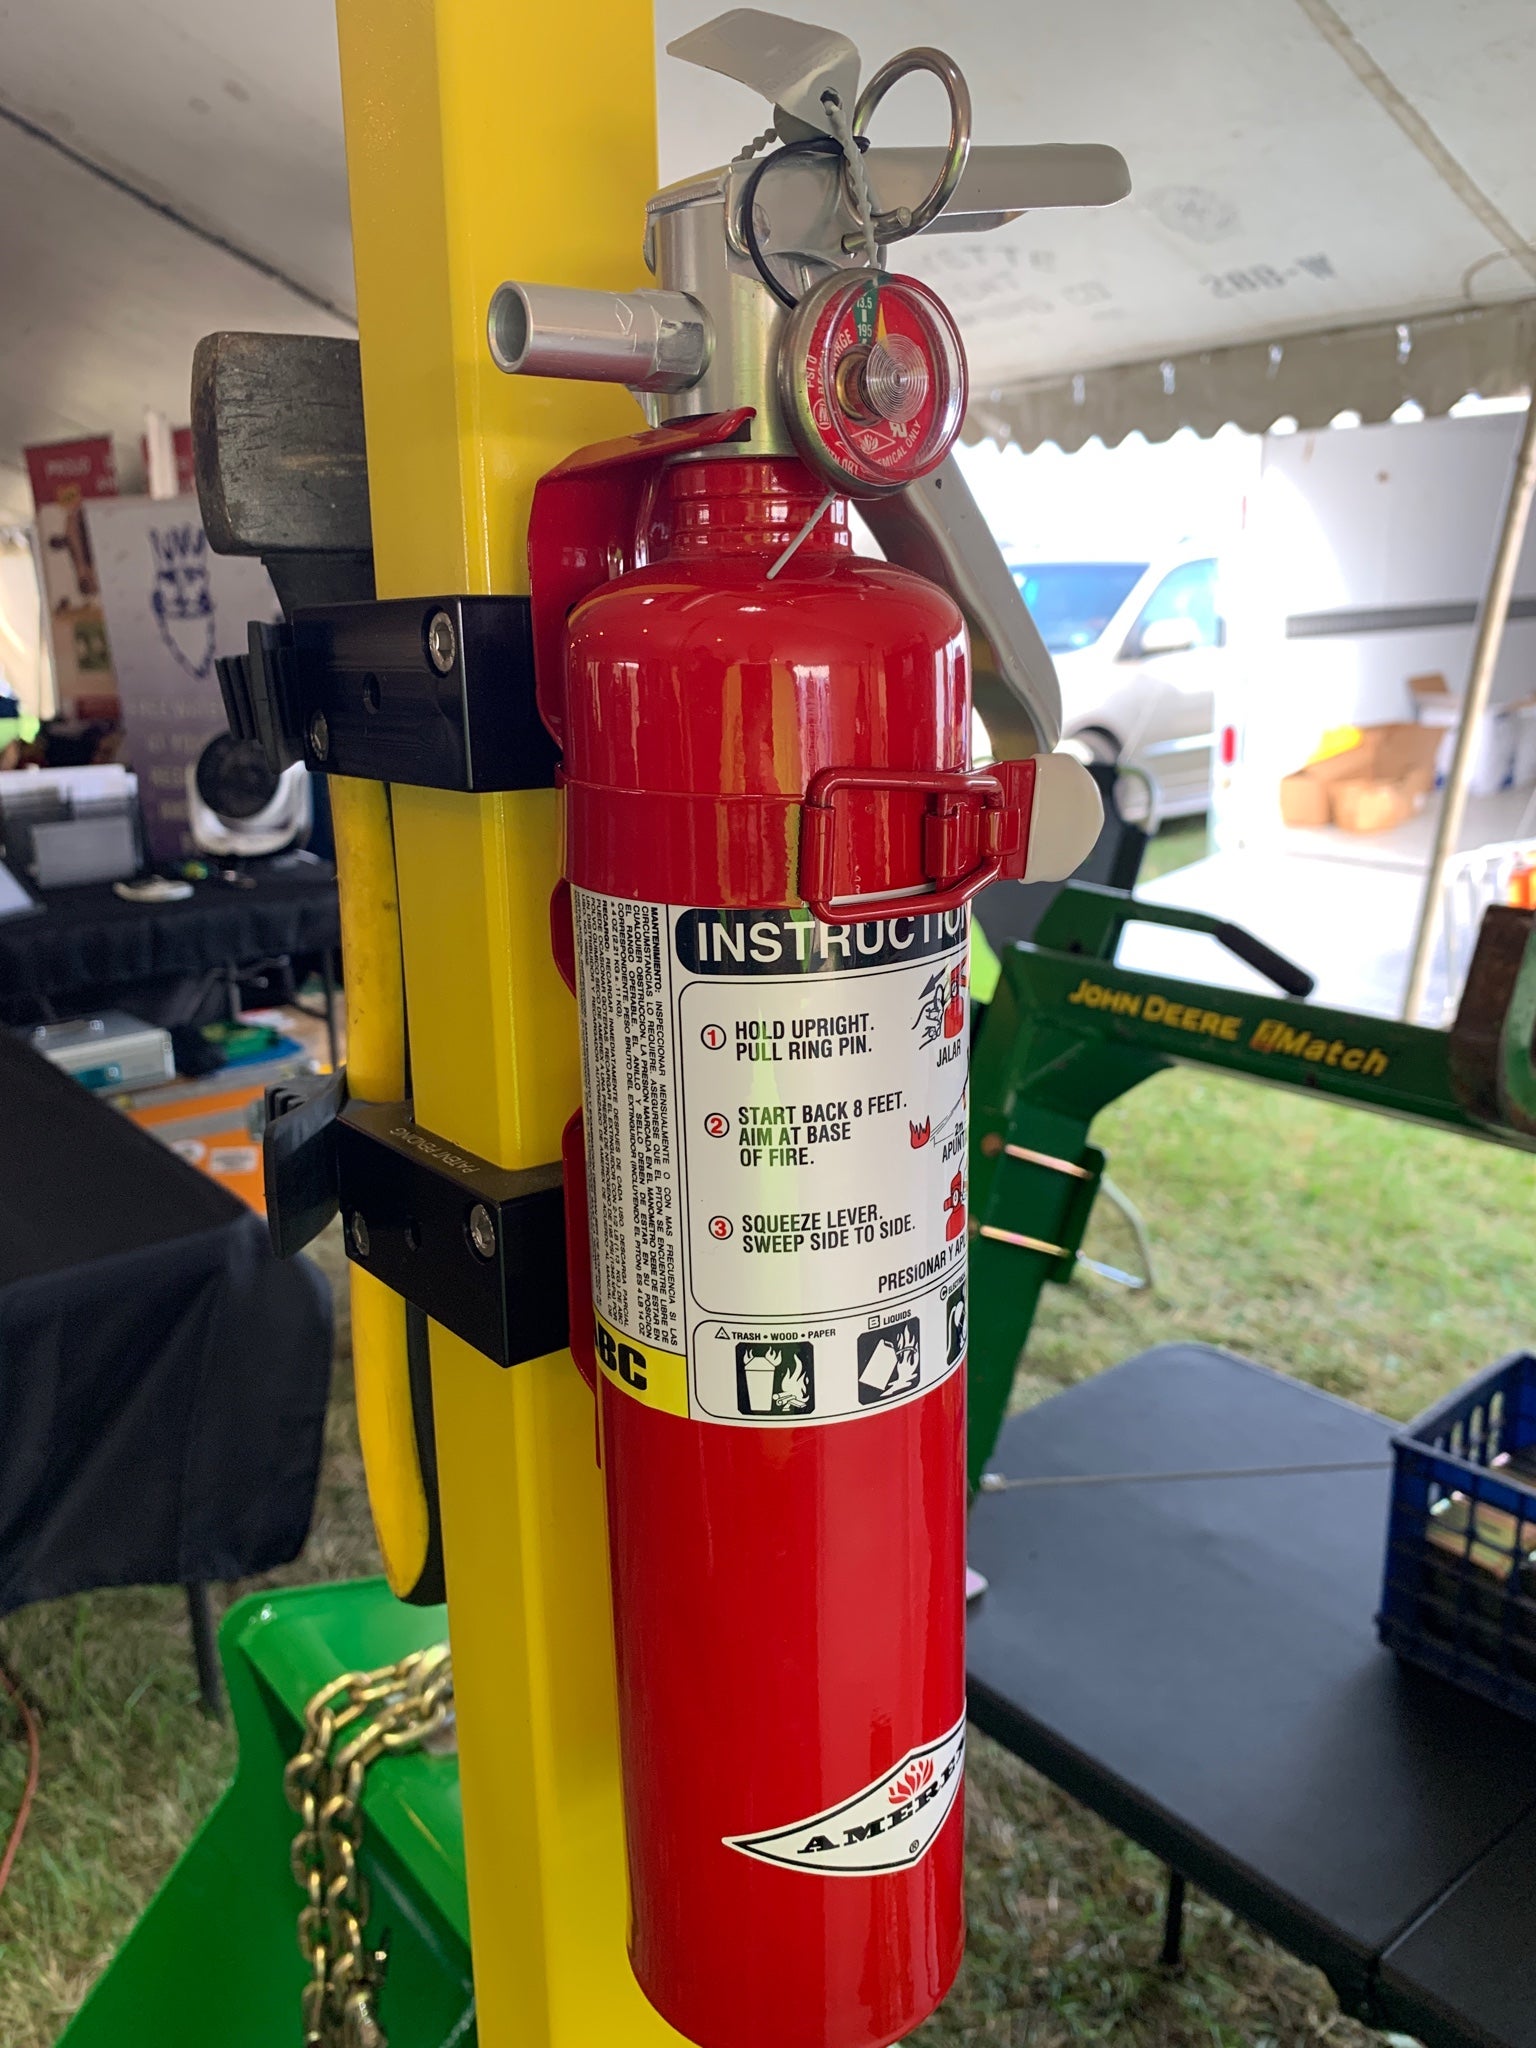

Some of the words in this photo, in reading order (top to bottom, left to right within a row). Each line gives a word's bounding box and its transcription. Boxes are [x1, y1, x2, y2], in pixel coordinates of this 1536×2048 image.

[858, 324, 872, 337] 195
[906, 419, 922, 449] ONLY
[625, 904, 632, 916] EL
[626, 925, 634, 963] RANGO
[633, 905, 643, 963] CUALQUIER
[618, 903, 629, 1003] CORRESPONDIENTE.
[651, 907, 662, 993] MANTENIMIENTO:
[605, 957, 613, 1013] RECARGAR
[628, 970, 637, 1027] OPERABLE.
[636, 966, 646, 1040] OBSTRUCCION.
[646, 1002, 654, 1015] LO
[1068, 979, 1142, 1017] JOHN
[1142, 995, 1243, 1041] DEERE
[632, 1035, 638, 1047] EL
[655, 1001, 666, 1076] INSPECCIONAR
[735, 1020, 785, 1041] HOLD
[792, 1013, 875, 1039] UPRIGHT.
[608, 1018, 618, 1103] INMEDIATAMENTE
[624, 1036, 632, 1070] BRUTO
[639, 1044, 647, 1056] LA
[647, 1021, 657, 1074] REQUIERE.
[736, 1041, 783, 1062] PULL
[789, 1038, 833, 1061] RING
[839, 1034, 872, 1056] PIN.
[936, 1040, 962, 1068] JALAR
[632, 1055, 641, 1090] ANILLO
[640, 1059, 649, 1103] PRESION
[650, 1079, 660, 1139] ASEGURESE
[738, 1105, 797, 1126] START
[802, 1101, 848, 1123] BACK
[853, 1099, 863, 1118] 8
[868, 1091, 907, 1116] FEET.
[627, 1094, 636, 1158] EXTINGUIDOR
[635, 1113, 643, 1144] SELLO
[642, 1105, 651, 1152] MARCADA
[659, 1084, 670, 1164] MENSUALMENTE
[738, 1127, 773, 1147] AIM
[779, 1126, 801, 1145] AT
[807, 1121, 851, 1144] BASE
[389, 1127, 437, 1157] PENDING
[653, 1144, 661, 1164] QUE
[942, 1130, 965, 1163] APUNT
[432, 1150, 480, 1174] PATENT
[637, 1151, 645, 1185] DEBEN
[645, 1156, 652, 1169] EN
[739, 1148, 763, 1167] OF
[769, 1147, 815, 1167] FIRE.
[645, 1172, 653, 1184] EL
[654, 1170, 661, 1181] EL
[663, 1172, 671, 1180] O
[630, 1161, 639, 1224] (INCLUYENDO
[639, 1192, 646, 1206] DE
[655, 1186, 663, 1215] PITON
[663, 1187, 672, 1208] CON
[640, 1213, 648, 1245] ESTAR
[646, 1187, 656, 1247] MANOMETRO
[656, 1220, 664, 1232] SE
[665, 1216, 673, 1236] MAS
[742, 1212, 821, 1233] SQUEEZE
[826, 1204, 883, 1229] LEVER.
[633, 1226, 640, 1237] EL
[742, 1235, 805, 1253] SWEEP
[810, 1231, 849, 1251] SIDE
[854, 1225, 875, 1245] TO
[879, 1214, 916, 1240] SIDE.
[619, 1233, 627, 1284] DESCARGA
[642, 1252, 649, 1266] EN
[649, 1251, 657, 1276] DEBE
[657, 1237, 667, 1295] ENCUENTRE
[878, 1250, 946, 1294] PRESIONAR
[948, 1243, 953, 1261] Y
[636, 1273, 642, 1285] ES
[643, 1272, 650, 1286] SU
[651, 1279, 658, 1292] DE
[666, 1244, 676, 1304] FRECUENCIA
[637, 1296, 643, 1307] LB
[638, 1311, 644, 1320] 14
[651, 1295, 659, 1325] ESTAR
[660, 1299, 668, 1326] LIBRE
[638, 1322, 645, 1336] OZ
[644, 1293, 652, 1339] POSICION
[669, 1312, 677, 1321] SI
[883, 1309, 912, 1325] LIQUIDS
[653, 1328, 660, 1341] EN
[661, 1330, 669, 1344] DE
[670, 1328, 678, 1346] LAS
[731, 1331, 762, 1341] TRASH
[770, 1330, 799, 1341] WOOD
[808, 1328, 837, 1339] PAPER
